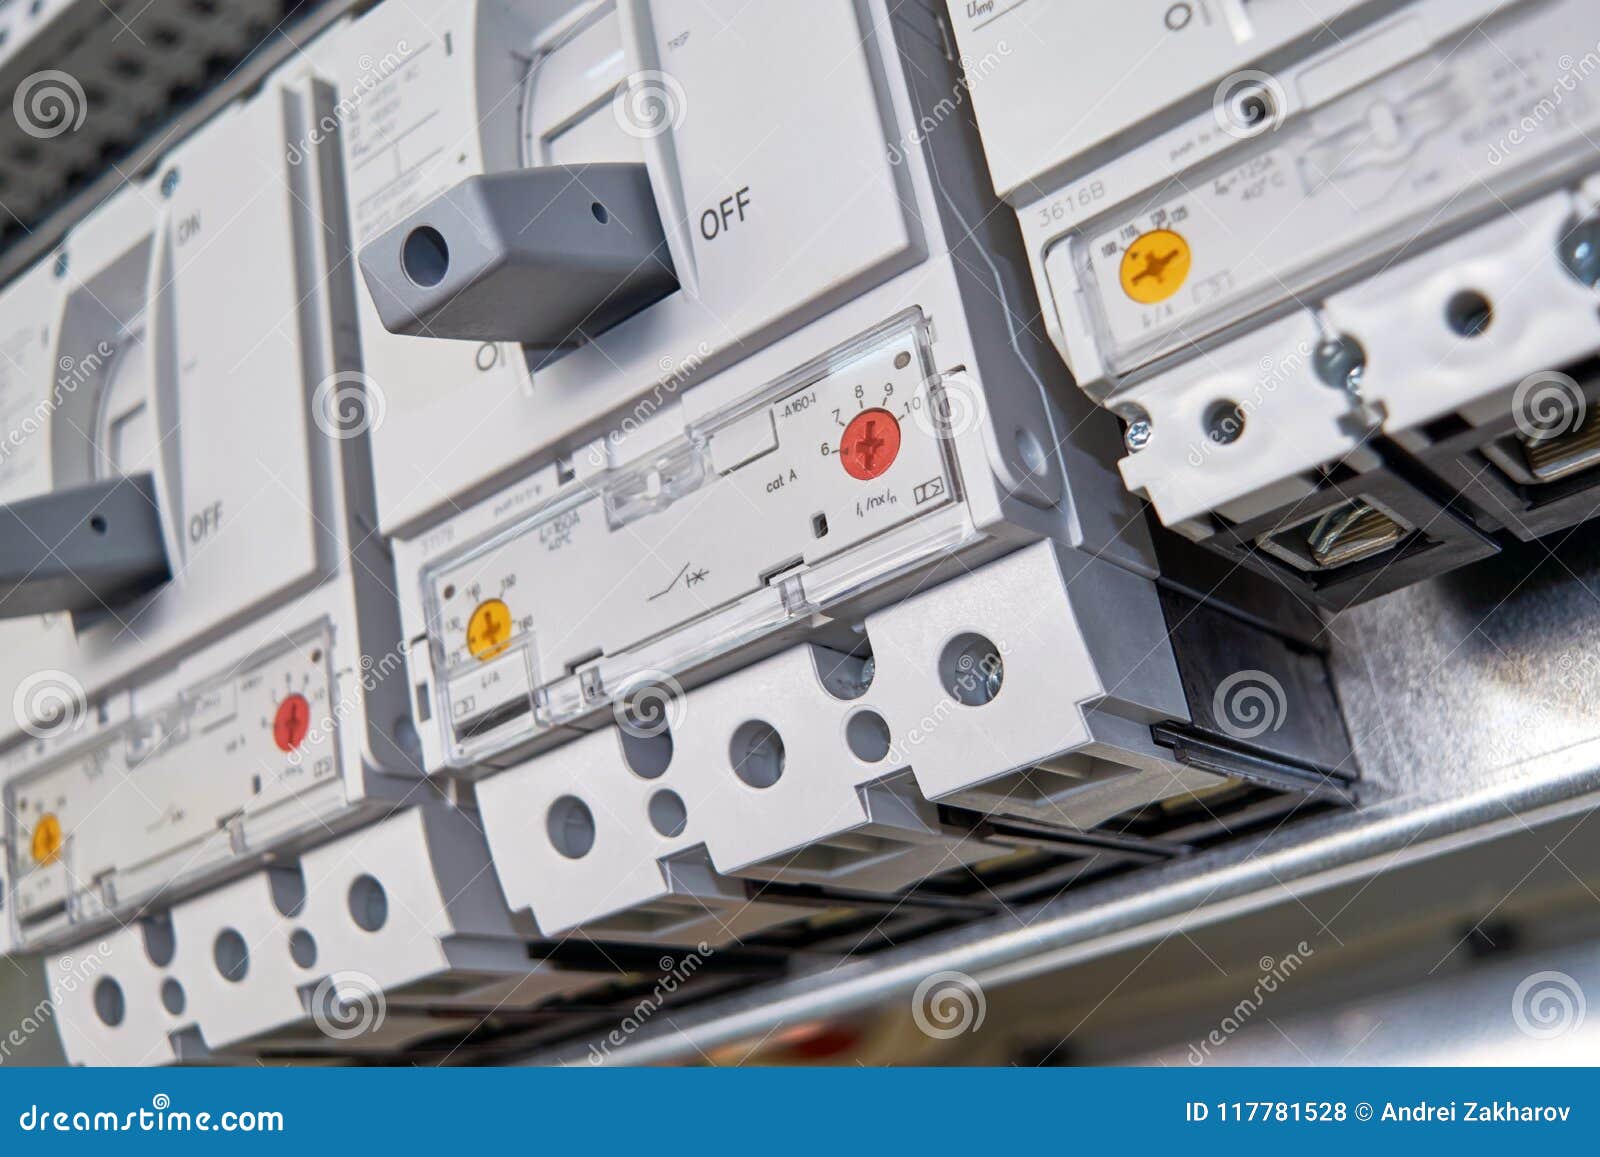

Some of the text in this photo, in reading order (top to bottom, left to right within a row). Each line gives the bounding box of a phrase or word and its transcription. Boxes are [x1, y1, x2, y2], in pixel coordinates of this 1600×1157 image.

[700, 186, 752, 241] OFF
[1039, 182, 1106, 228] 3616B
[854, 384, 865, 399] 8
[883, 382, 894, 397] 9
[903, 396, 922, 415] 10
[831, 408, 842, 424] 7
[820, 442, 831, 457] 6
[766, 468, 798, 494] cat A
[190, 499, 223, 543] OFF
